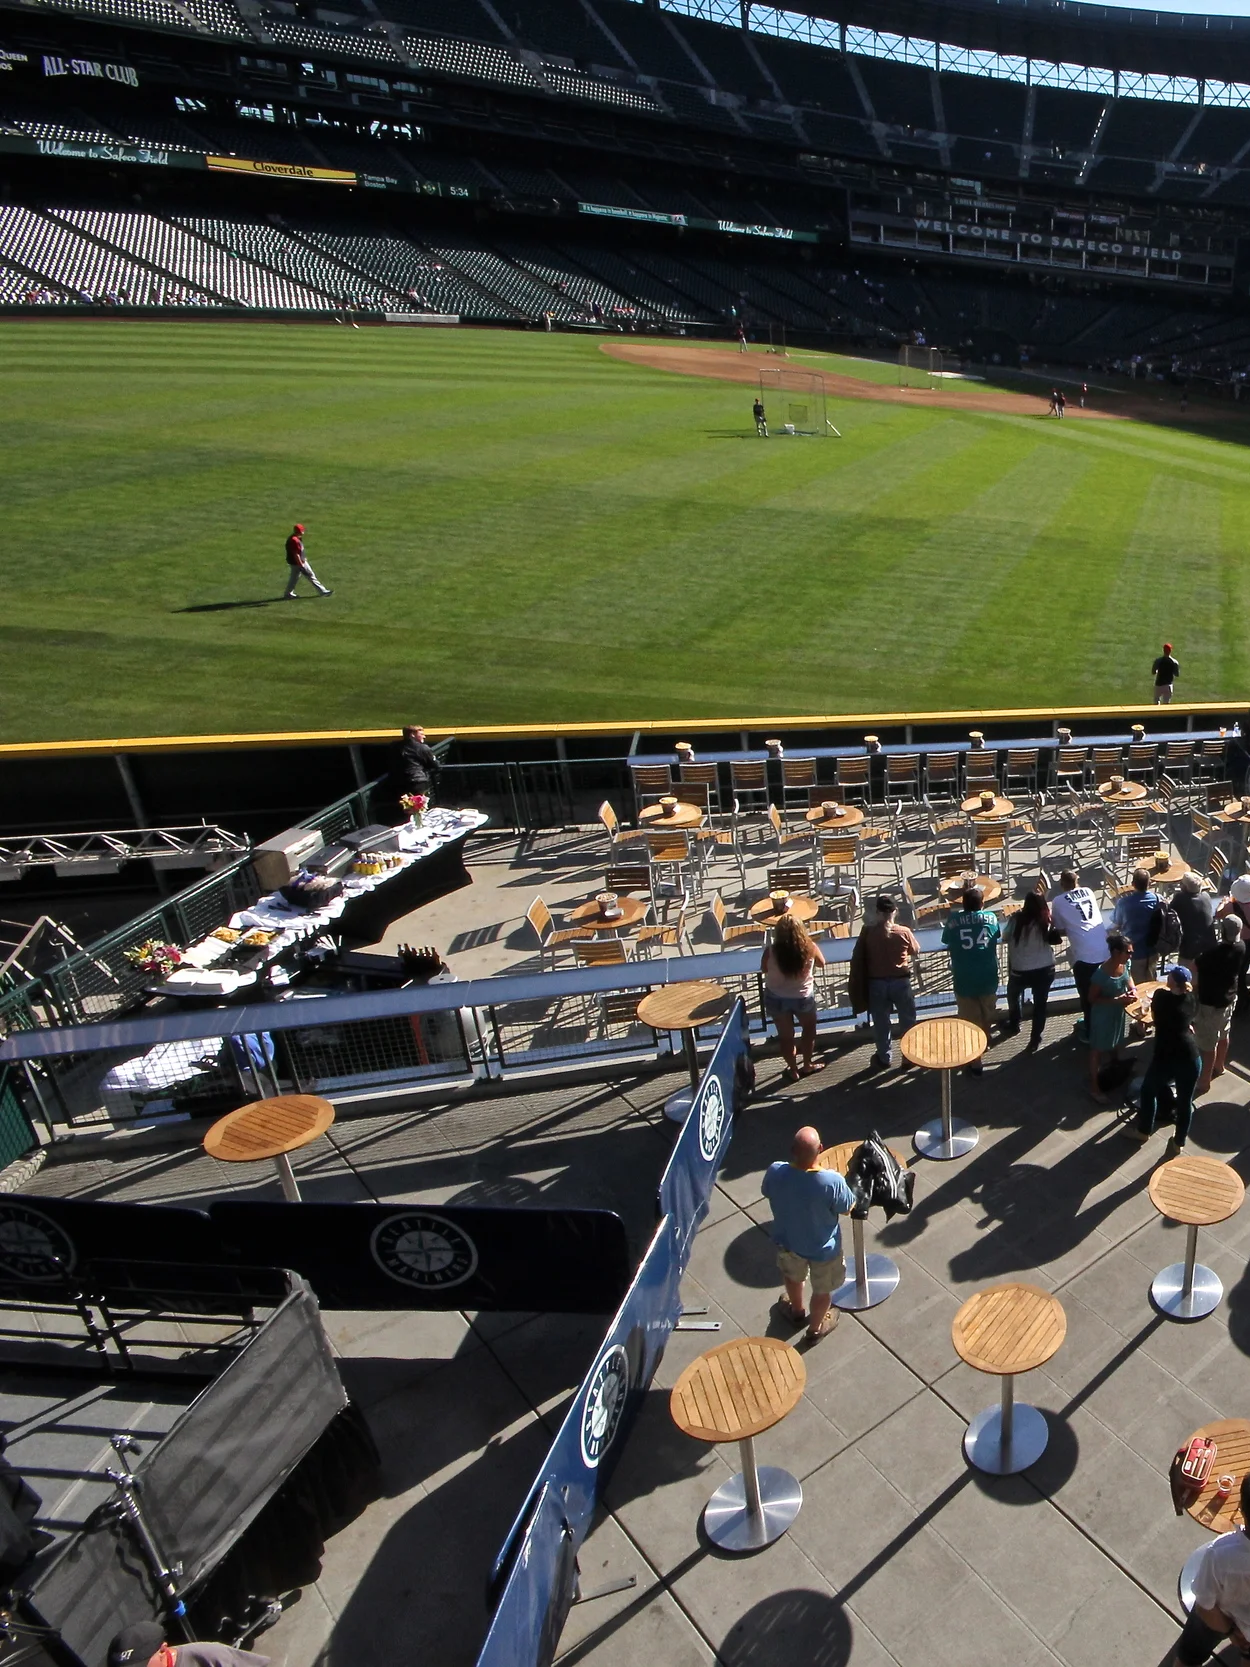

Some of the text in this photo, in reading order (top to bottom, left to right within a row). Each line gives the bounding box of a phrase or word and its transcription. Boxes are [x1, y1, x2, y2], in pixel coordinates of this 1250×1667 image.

[105, 63, 139, 88] CLUB
[37, 139, 169, 165] Welcome to Safeco Field
[253, 162, 314, 178] Cloverdale
[450, 186, 469, 197] 5:34
[914, 217, 1181, 260] WELCOME TO SAFECO FIELD
[1076, 899, 1093, 921] 17
[960, 927, 990, 950] 54
